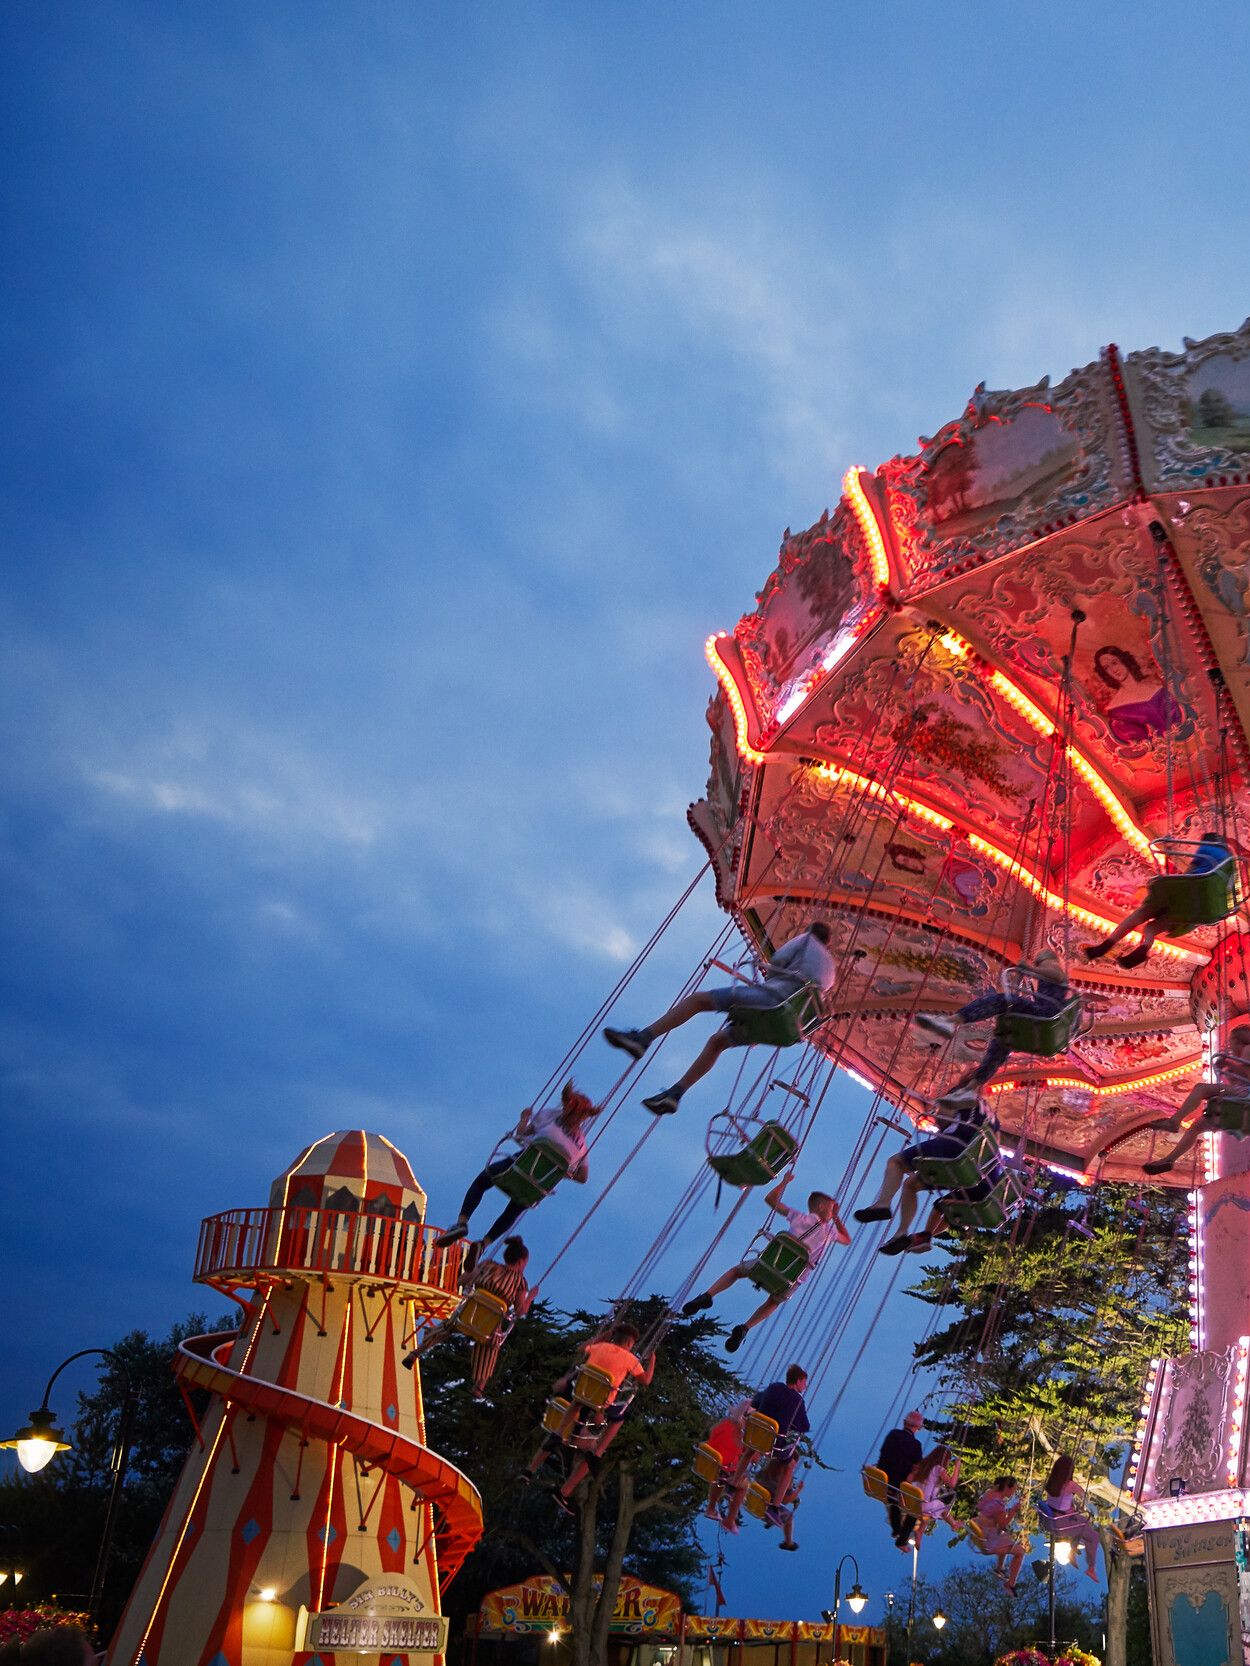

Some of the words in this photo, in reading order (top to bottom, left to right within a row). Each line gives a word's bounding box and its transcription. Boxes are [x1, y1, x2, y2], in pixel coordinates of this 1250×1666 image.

[377, 1584, 425, 1613] BILLY'S
[318, 1616, 379, 1648] HELTER
[381, 1619, 440, 1649] SKELTER
